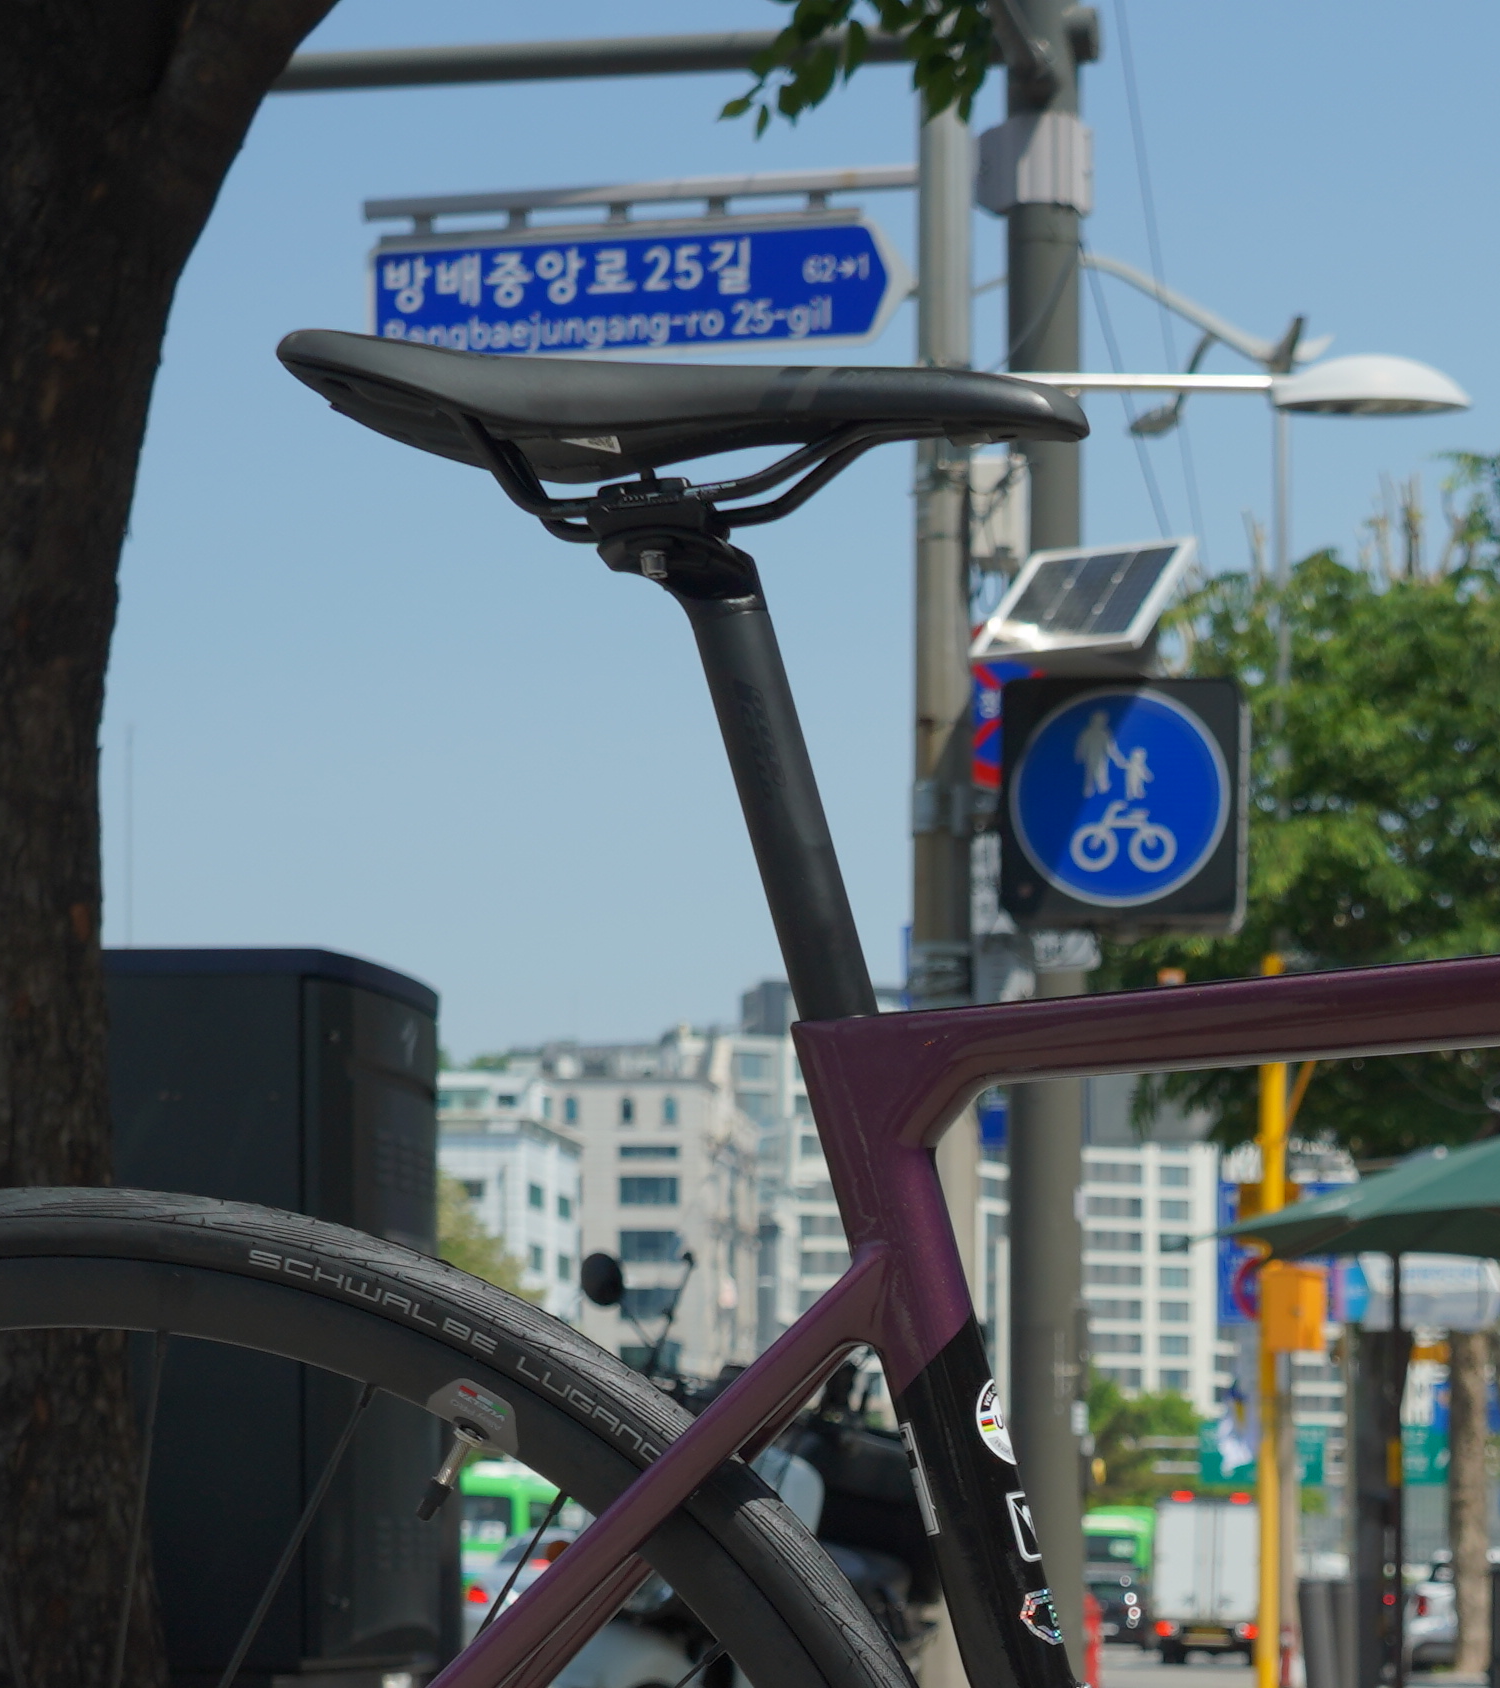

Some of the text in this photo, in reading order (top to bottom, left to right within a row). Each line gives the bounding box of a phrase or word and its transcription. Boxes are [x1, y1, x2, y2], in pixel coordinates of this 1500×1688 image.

[383, 238, 752, 314] 방배중앙로25길
[733, 297, 831, 338] 25-gil
[250, 1250, 498, 1354] SCHWALBE
